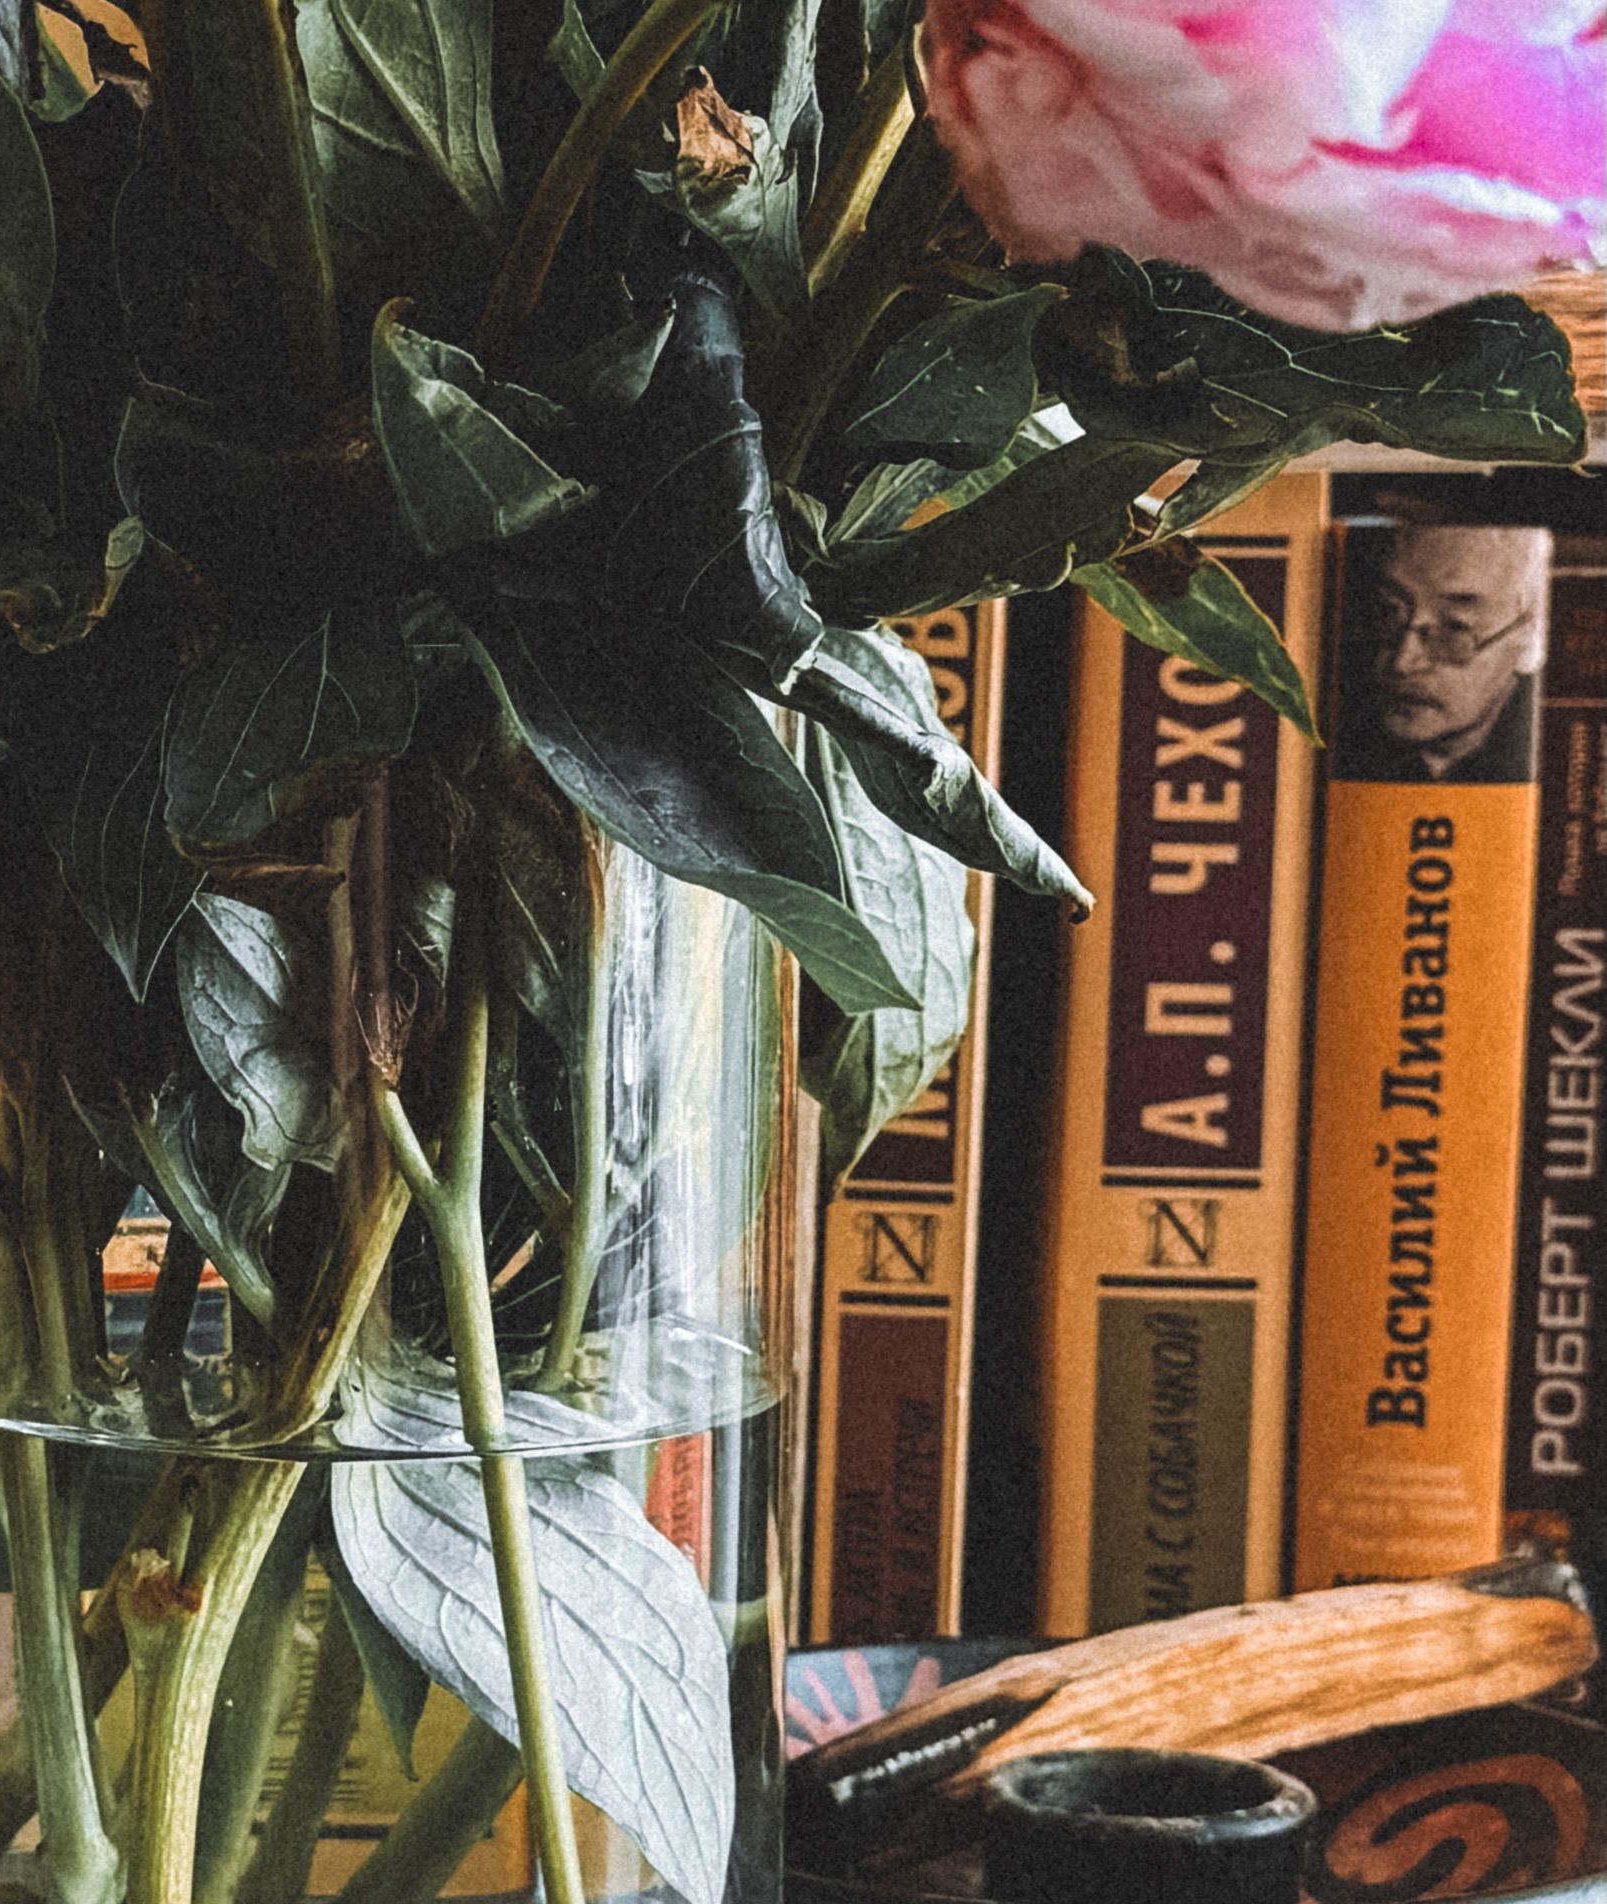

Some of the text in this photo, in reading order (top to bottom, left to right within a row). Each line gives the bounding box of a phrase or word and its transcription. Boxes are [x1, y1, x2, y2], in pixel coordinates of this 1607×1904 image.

[1140, 652, 1246, 1149] А.П. ЧЕХО
[1378, 813, 1456, 1119] Ливанов
[1540, 926, 1606, 1179] ШЕКЛИ
[1363, 1134, 1441, 1431] Василий
[1530, 1196, 1594, 1476] РОБЕРТ
